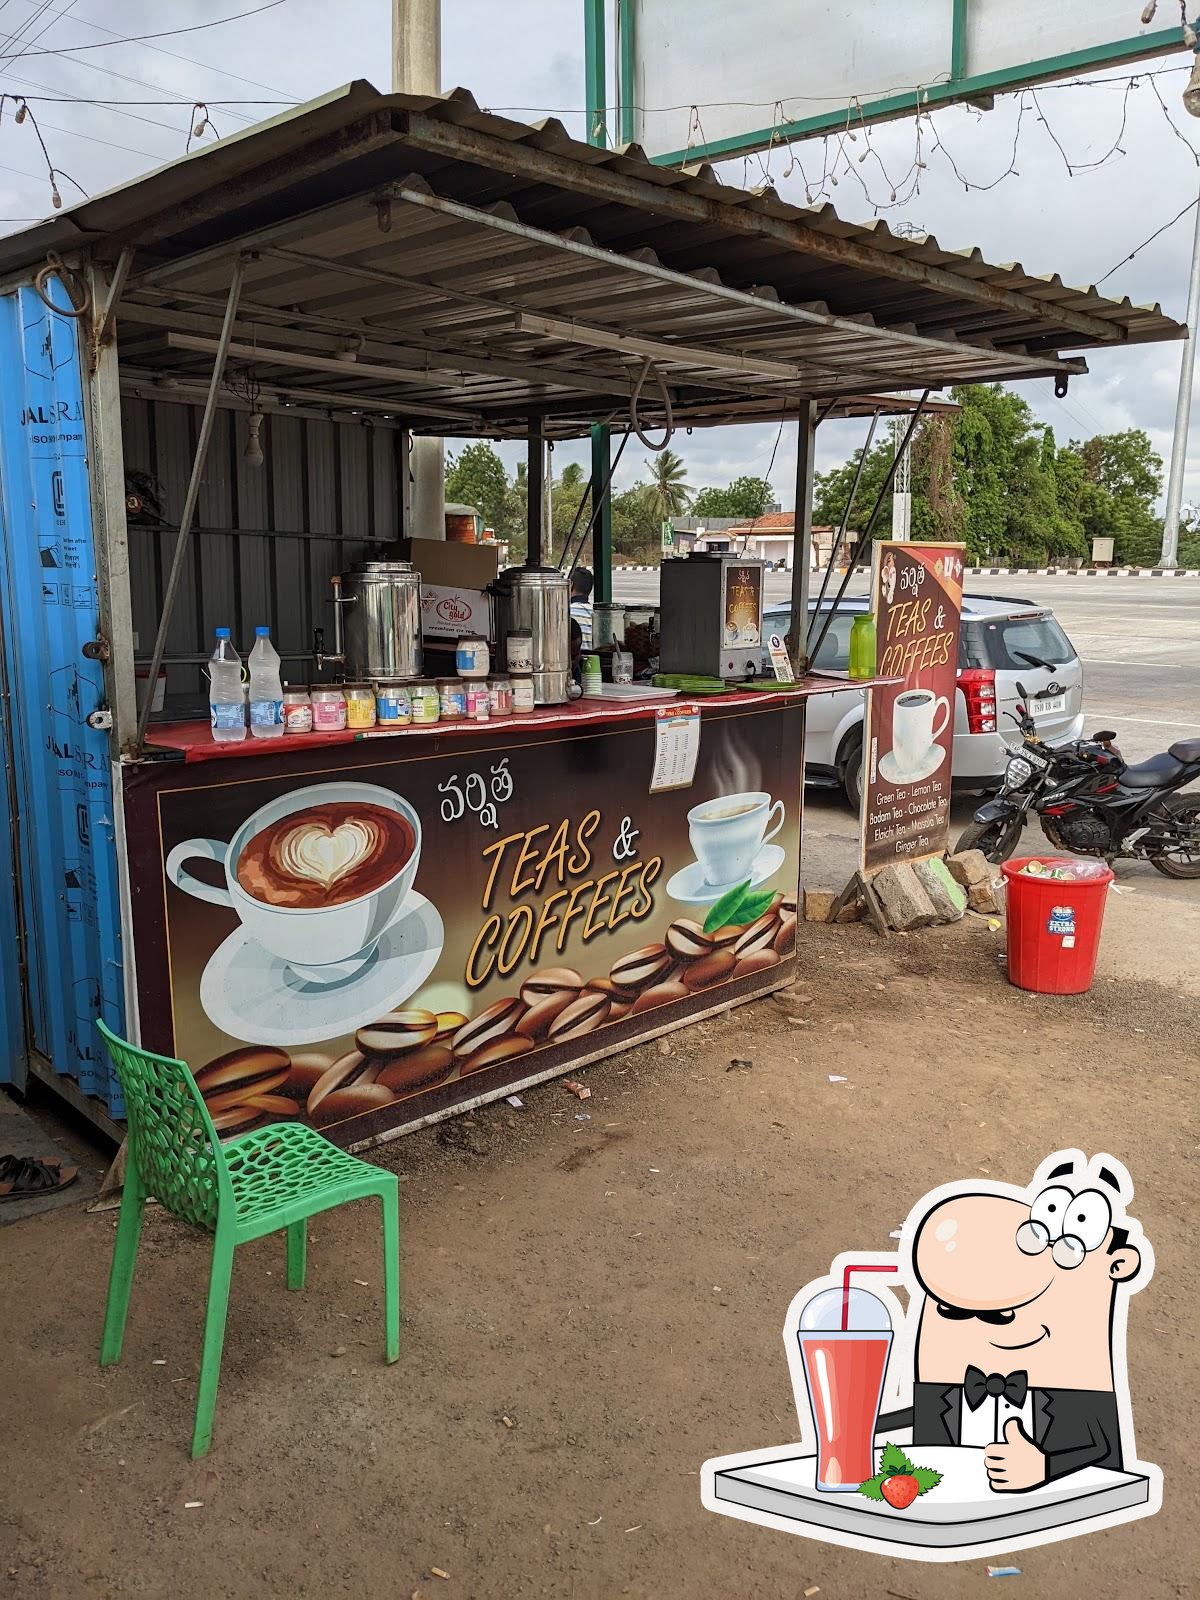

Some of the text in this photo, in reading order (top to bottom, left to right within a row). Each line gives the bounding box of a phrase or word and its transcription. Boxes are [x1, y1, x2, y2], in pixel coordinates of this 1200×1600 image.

[443, 601, 458, 612] City
[887, 598, 946, 641] TEAS &
[880, 631, 954, 676] COFFEES
[438, 757, 514, 829] వర్షిత
[870, 810, 891, 825] Badam
[892, 807, 903, 818] Tea
[908, 799, 937, 815] Chocolate
[938, 796, 947, 807] Tea
[877, 793, 894, 805] Green
[896, 789, 906, 800] Tea
[912, 785, 930, 796] Lemon
[932, 781, 942, 792] Tea
[874, 825, 894, 841] Elaichi
[896, 824, 906, 835] Tea
[912, 816, 934, 831] Masala
[934, 814, 944, 825] Tea
[895, 835, 929, 853] Ginger Tea
[482, 810, 640, 909] TEAS &
[466, 856, 662, 986] COFFEES
